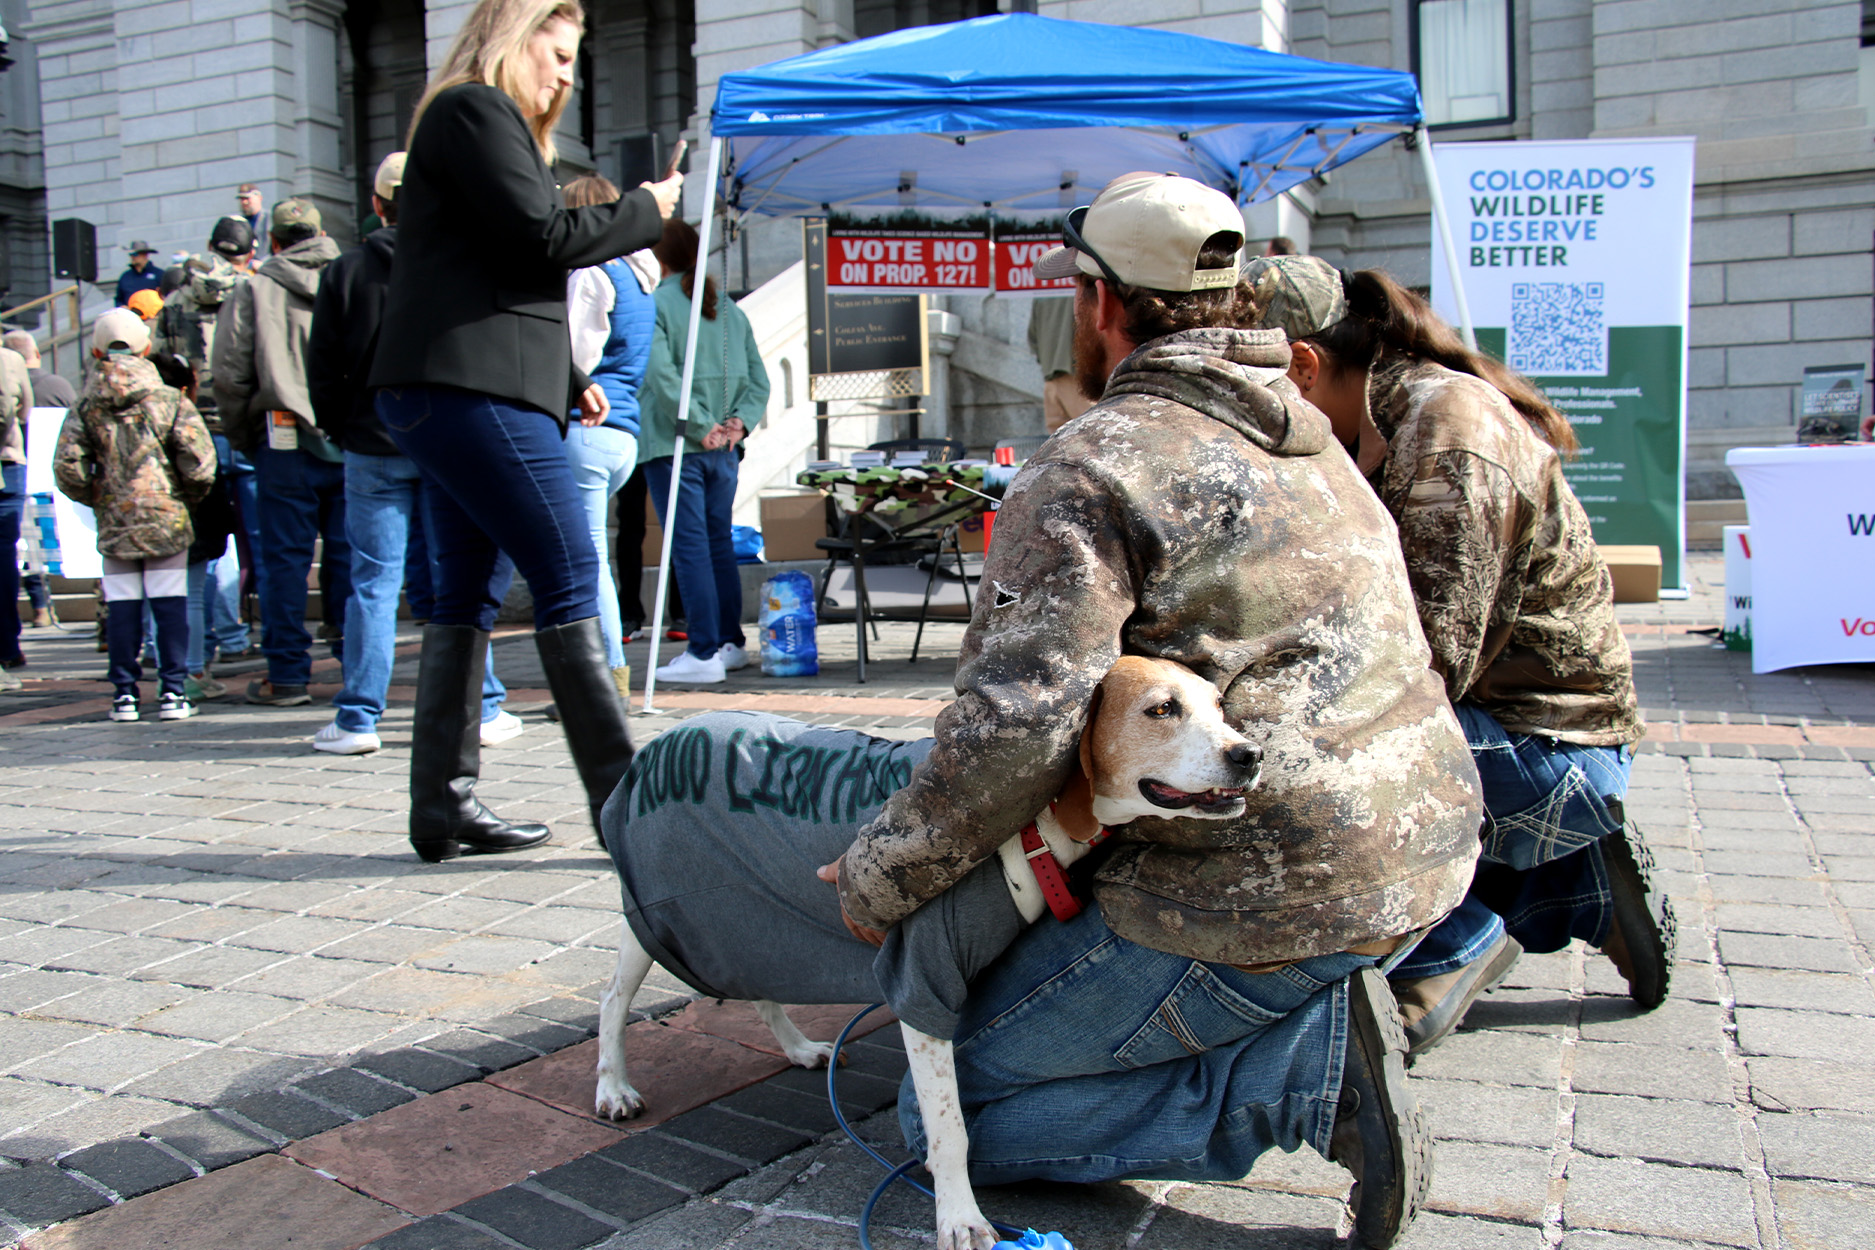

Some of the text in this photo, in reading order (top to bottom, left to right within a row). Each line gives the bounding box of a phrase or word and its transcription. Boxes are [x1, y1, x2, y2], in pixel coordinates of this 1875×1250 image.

[1469, 167, 1655, 191] COLORADO'S
[1470, 194, 1604, 217] WILDLIFE
[1470, 220, 1597, 242] DESERVE
[841, 240, 977, 262] VOTE NO
[1470, 245, 1568, 268] BETTER
[840, 263, 977, 285] ON PROP. 127!
[1007, 267, 1036, 288] ON
[1545, 386, 1579, 397] Wildlife
[1580, 386, 1642, 400] Management,
[785, 615, 795, 653] WATER
[725, 728, 846, 824] LION
